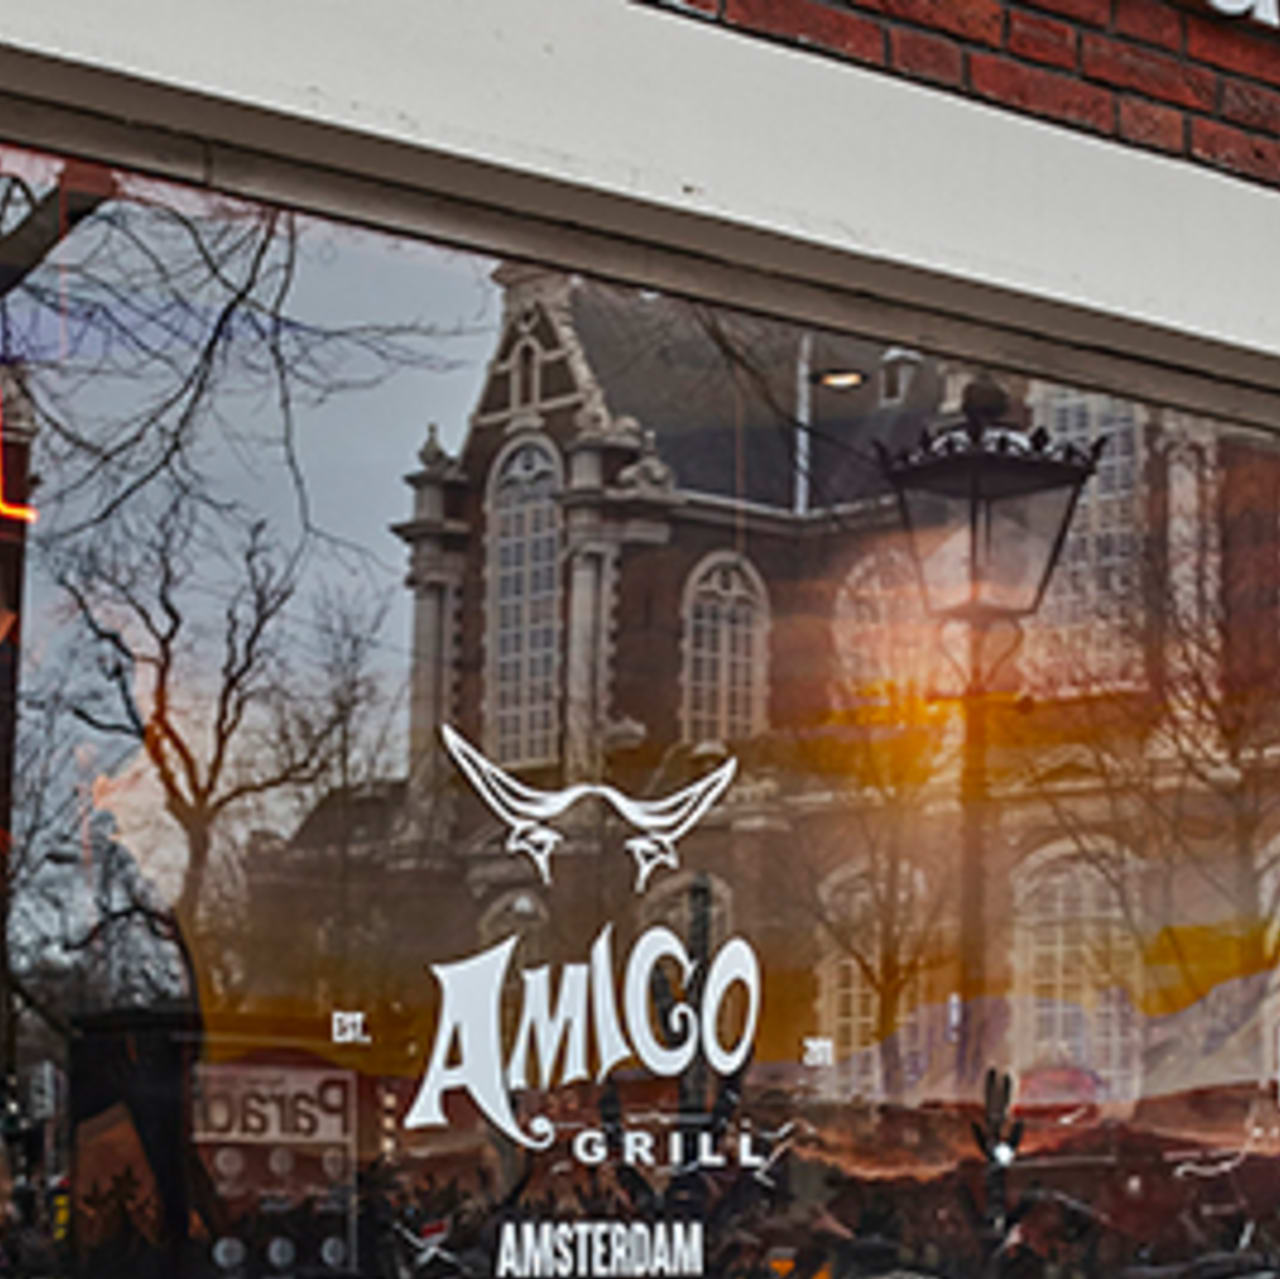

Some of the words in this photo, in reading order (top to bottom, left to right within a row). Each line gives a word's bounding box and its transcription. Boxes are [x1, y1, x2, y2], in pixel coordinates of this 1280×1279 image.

[403, 921, 761, 1151] AMIGO
[573, 1130, 764, 1166] GRILL
[497, 1222, 703, 1278] AMSTERDAM
